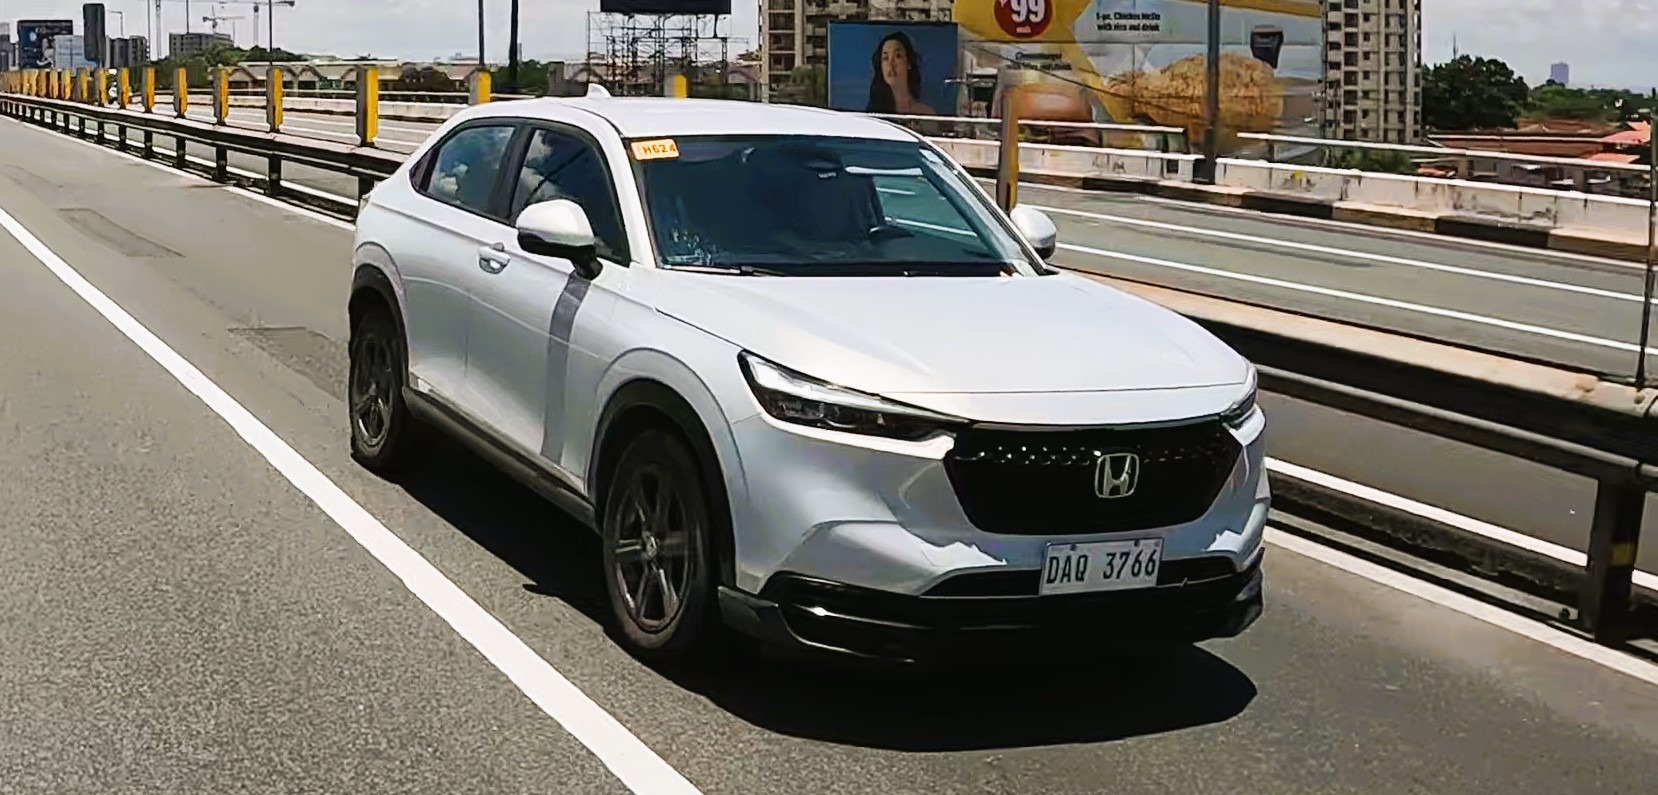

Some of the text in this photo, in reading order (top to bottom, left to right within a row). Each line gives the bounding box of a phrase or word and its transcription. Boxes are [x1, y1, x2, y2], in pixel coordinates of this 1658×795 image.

[1097, 22, 1112, 31] with
[1128, 22, 1140, 31] and
[1141, 22, 1160, 31] drink
[1046, 550, 1157, 584] DAQ 3766
